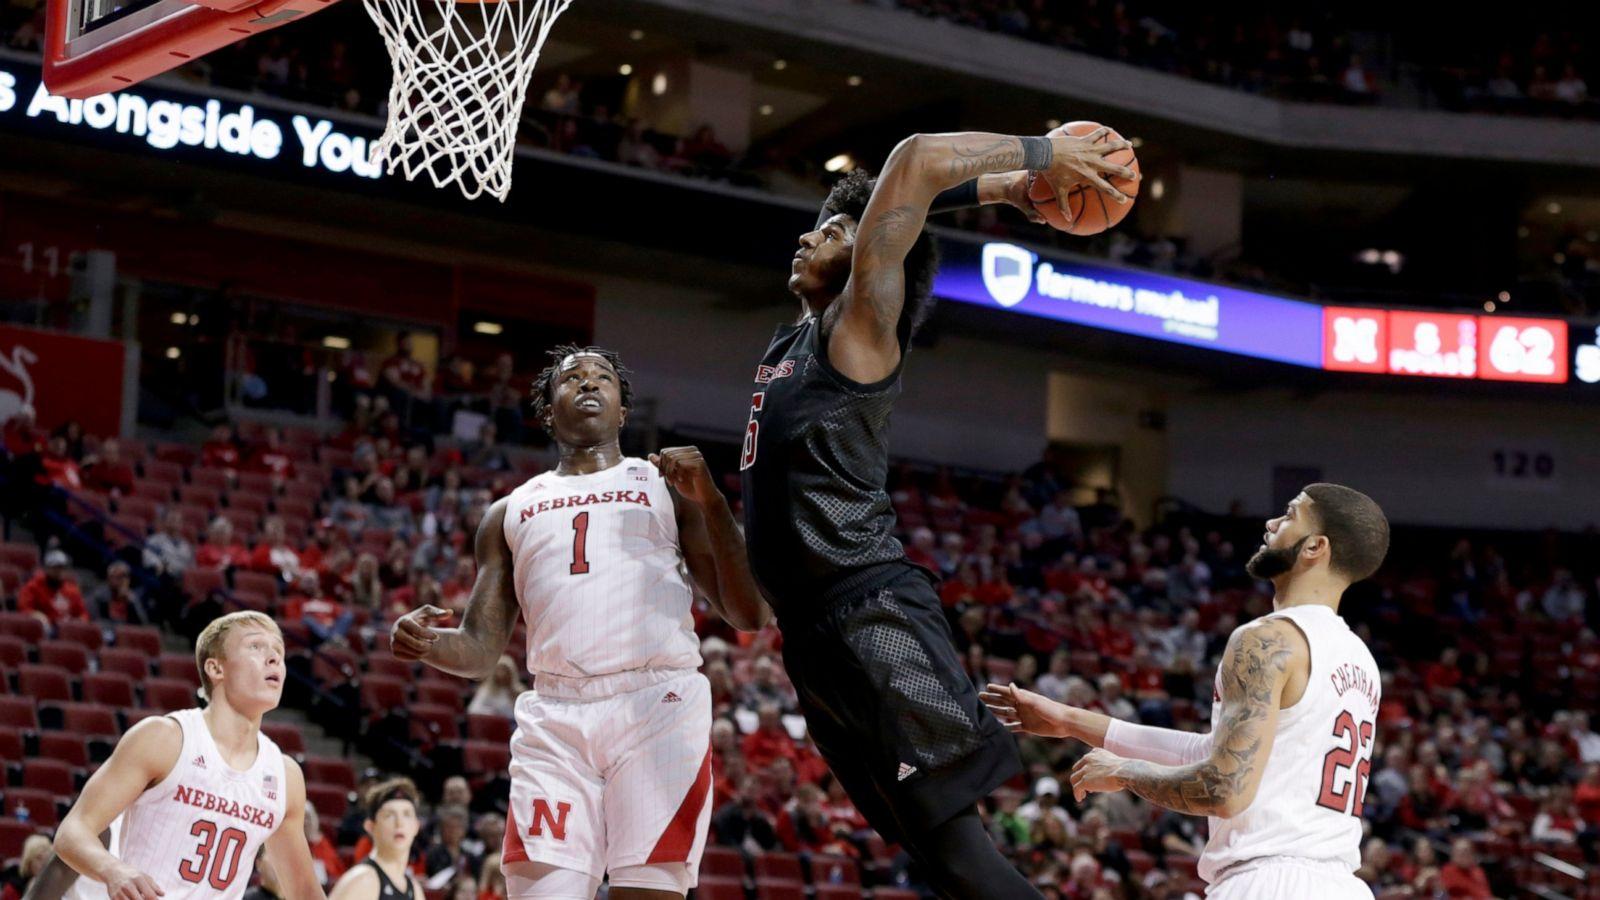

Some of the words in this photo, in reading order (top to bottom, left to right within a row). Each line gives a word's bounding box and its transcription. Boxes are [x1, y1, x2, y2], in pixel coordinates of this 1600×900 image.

[26, 80, 283, 160] Alongside
[1489, 325, 1555, 375] 62
[1493, 450, 1555, 479] 120
[519, 490, 652, 524] NEBRASKA
[569, 511, 590, 576] 1
[1315, 709, 1373, 818] 22
[173, 784, 275, 830] NEBRASKA
[528, 798, 572, 841] N
[178, 818, 248, 892] 30
